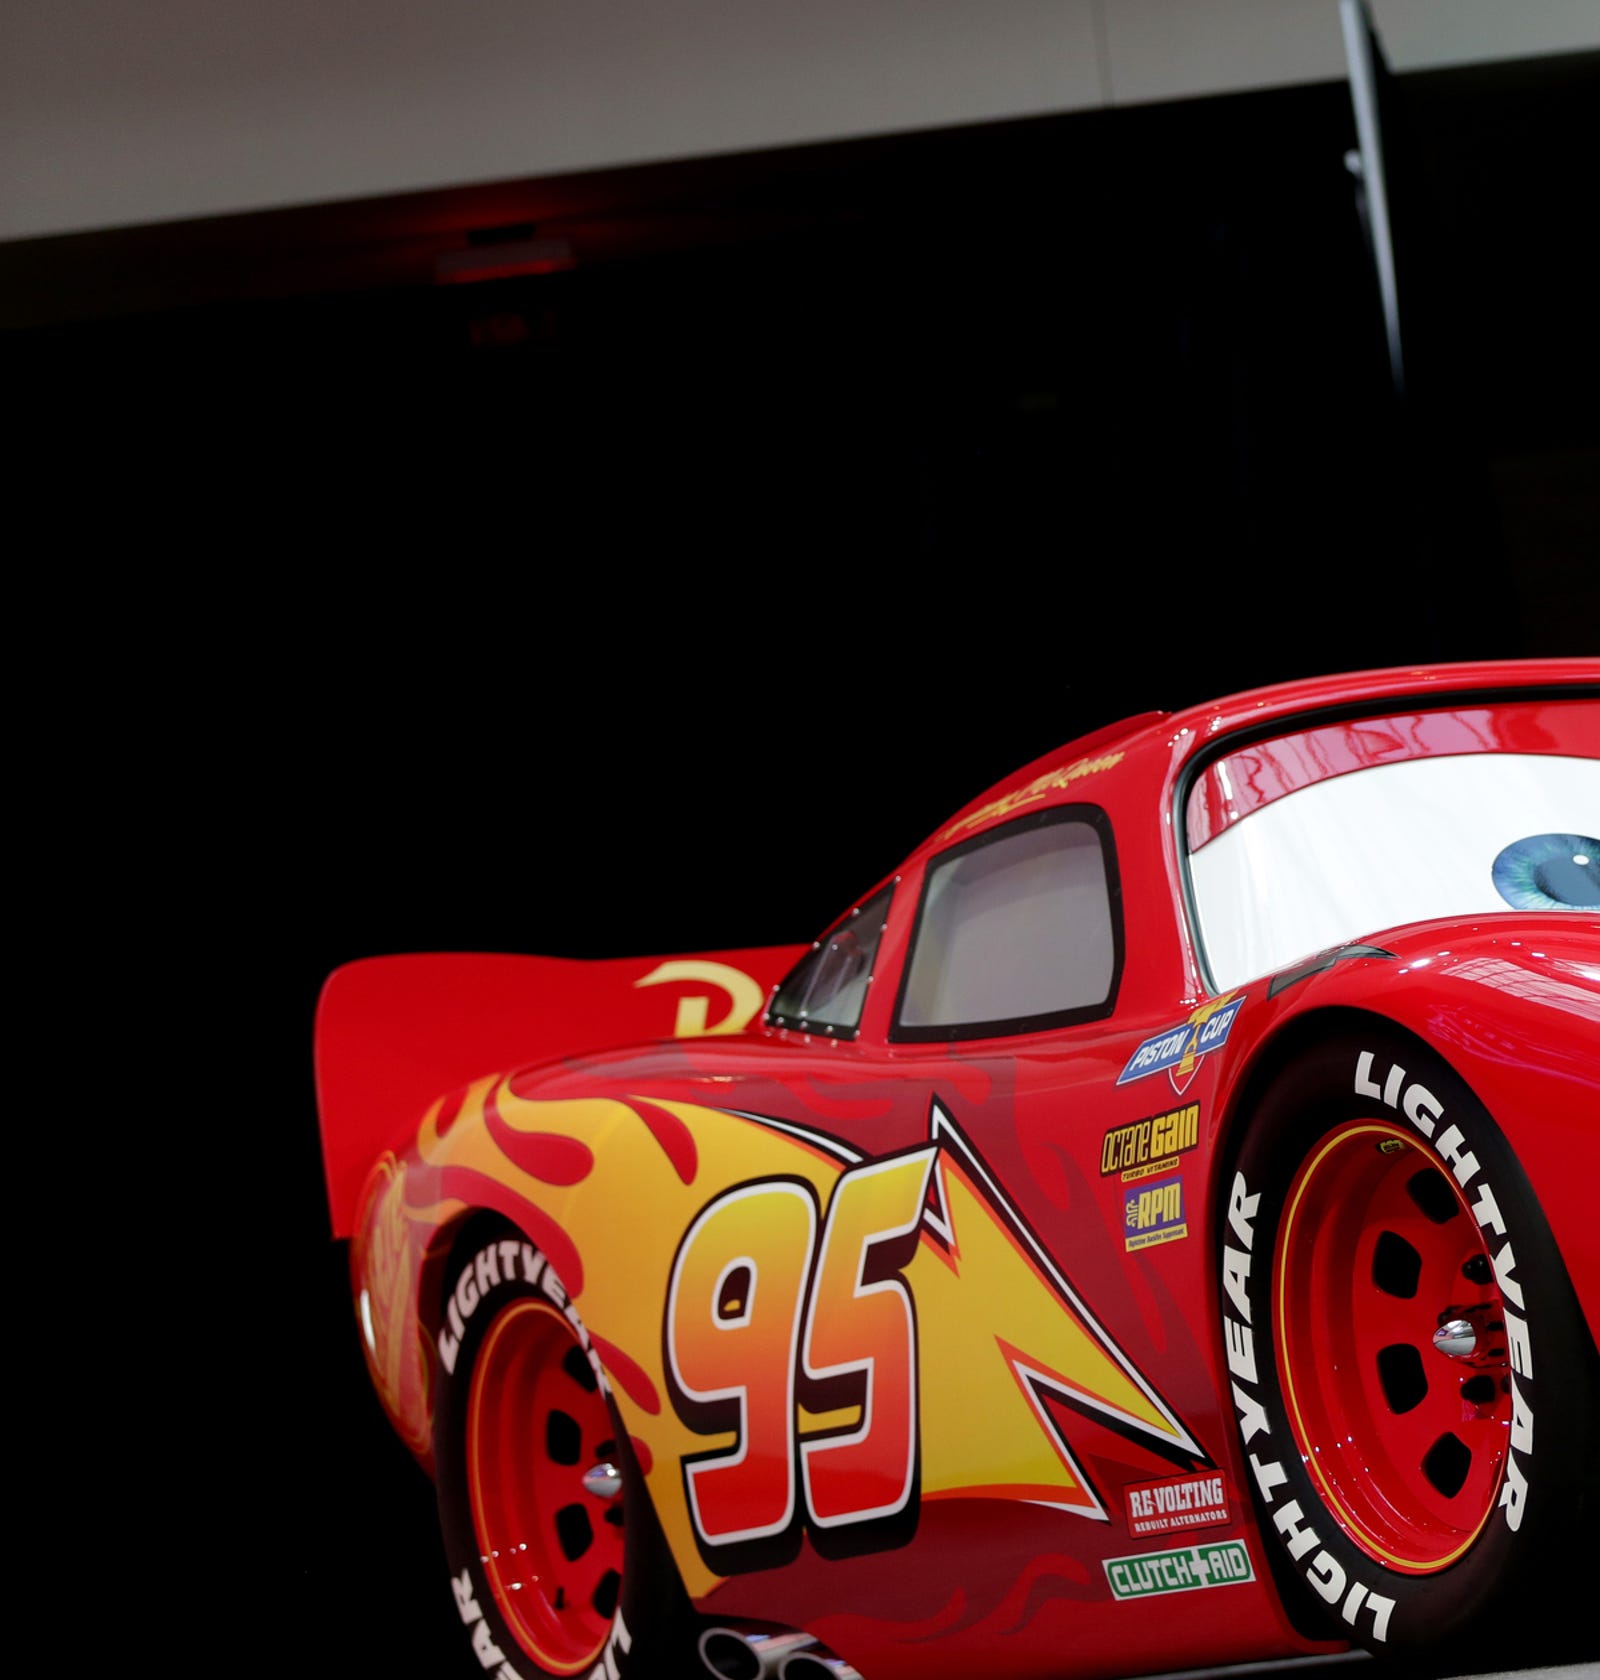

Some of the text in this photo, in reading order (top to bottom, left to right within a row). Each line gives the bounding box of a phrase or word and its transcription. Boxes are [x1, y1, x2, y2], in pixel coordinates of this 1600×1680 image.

[1128, 1008, 1235, 1072] PISTON CUP
[1137, 1182, 1181, 1230] RPM
[1354, 1050, 1534, 1532] LIGHTYEAR
[663, 1142, 941, 1562] 95
[1223, 1170, 1397, 1643] LIGHTYEAR
[1133, 1518, 1169, 1533] REBUILT
[1111, 1547, 1248, 1594] CLUTCH AID
